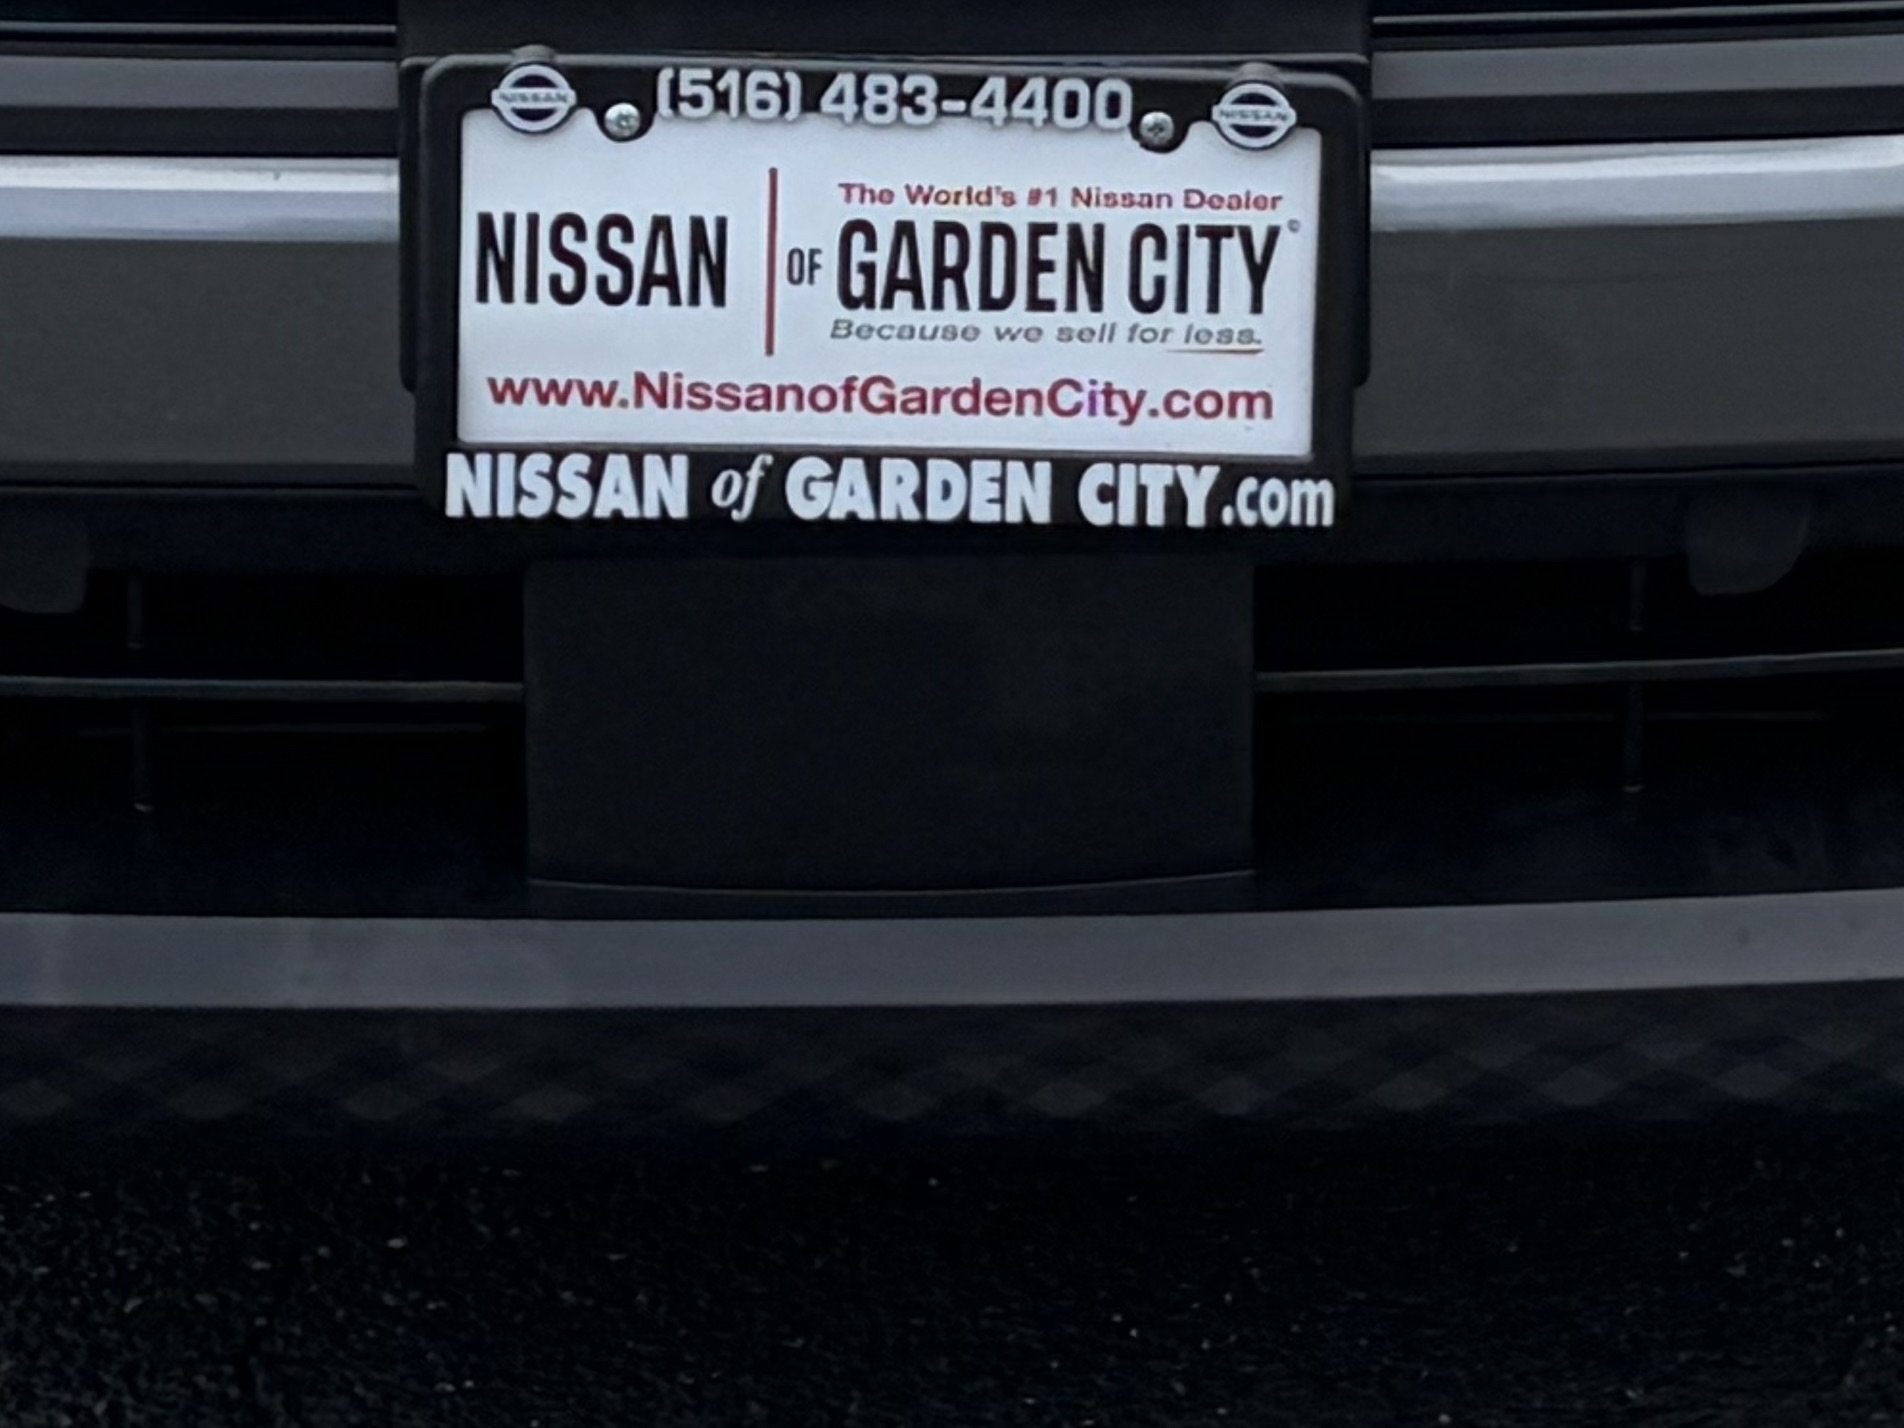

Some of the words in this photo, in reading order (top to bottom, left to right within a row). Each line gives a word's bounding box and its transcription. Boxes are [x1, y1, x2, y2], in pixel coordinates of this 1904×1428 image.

[655, 66, 803, 122] (516)
[819, 72, 1133, 131] 483-4400
[837, 181, 895, 206] The
[904, 183, 1017, 208] World's
[1027, 187, 1058, 208] #1
[1071, 187, 1173, 210] Nissan
[1184, 188, 1283, 211] Dealer
[475, 211, 728, 308] NISSAN
[786, 247, 823, 286] OF
[836, 217, 1105, 312] GARDEN
[1128, 223, 1281, 315] CITY
[829, 318, 981, 343] Because
[995, 325, 1044, 343] we
[1055, 322, 1116, 344] sell
[1126, 322, 1175, 344] for
[1183, 322, 1264, 346] less.
[487, 369, 1274, 427] www.NissanofGardenCity.com
[445, 451, 689, 520] NISSAN
[711, 453, 774, 523] of
[784, 455, 1053, 525] GARDEN
[1077, 462, 1335, 528] CITY.com
